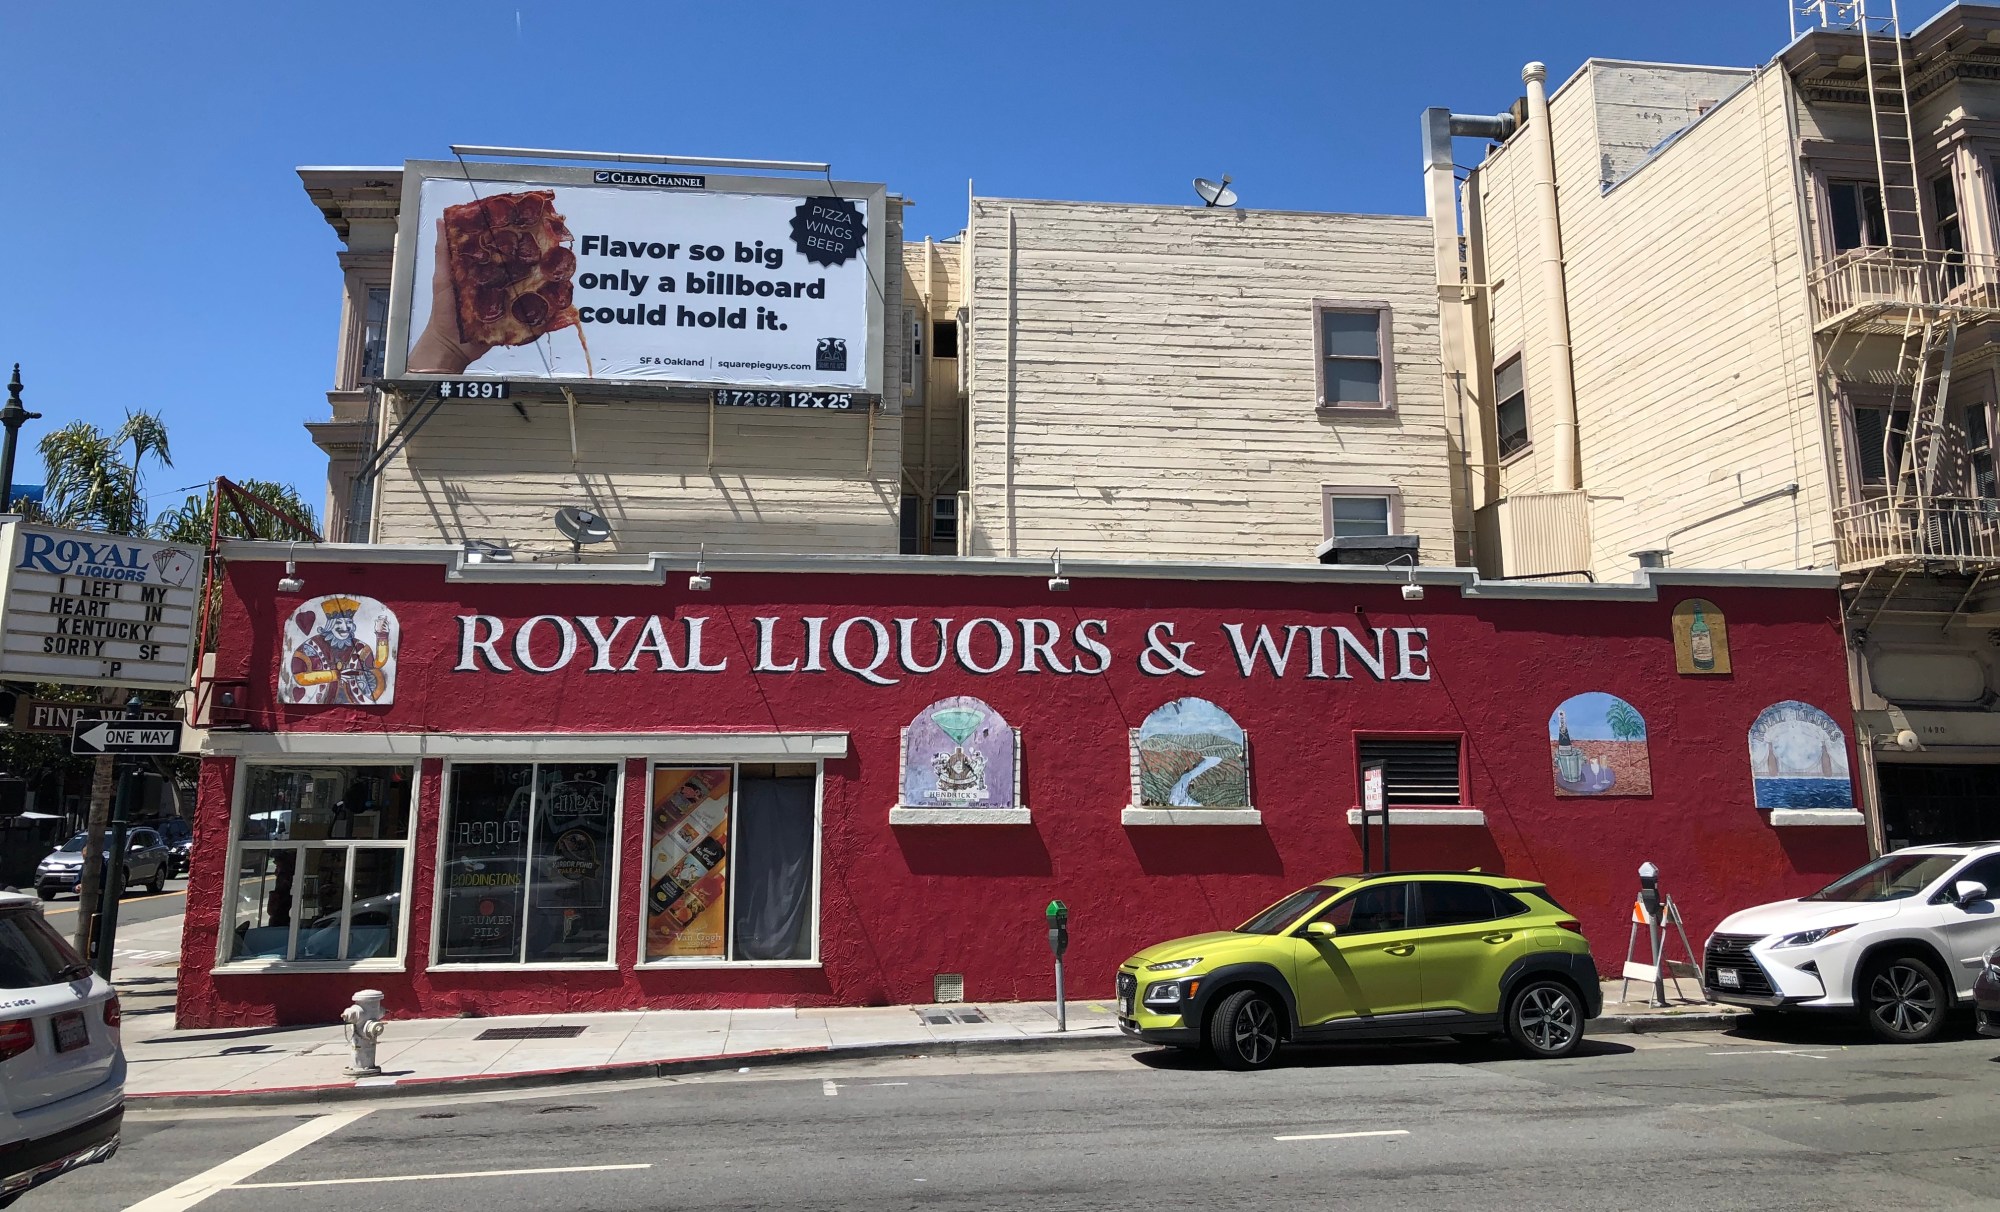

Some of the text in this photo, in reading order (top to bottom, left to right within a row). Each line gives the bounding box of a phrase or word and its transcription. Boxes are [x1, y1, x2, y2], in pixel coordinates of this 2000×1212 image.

[812, 205, 852, 225] PIZZA
[806, 219, 853, 240] WINGS
[581, 235, 783, 269] Flavor so big
[807, 235, 844, 254] BEER
[579, 269, 825, 299] only a billboard
[579, 303, 788, 331] could hold it.
[639, 357, 652, 365] SF
[654, 357, 661, 365] &
[663, 357, 705, 367] Oakland
[717, 359, 811, 371] squarepieguys.com
[16, 532, 150, 575] ROYAL
[75, 564, 147, 583] LIQUORS
[59, 578, 168, 604] I LEFT MY
[49, 597, 162, 622] HEART IN
[57, 618, 153, 640] KENTUCKY
[44, 637, 160, 660] SORRY SF
[454, 614, 1431, 687] ROYAL LIQUORS & WINE
[33, 706, 85, 727] FINE
[1752, 709, 1842, 743] ROYAL LIQUORS
[105, 731, 170, 744] ONE WAY
[559, 794, 599, 812] IPA
[929, 791, 977, 799] HENDRICK'S
[458, 820, 521, 845] ROGUE
[452, 873, 522, 887] BODDINGTONS
[460, 916, 514, 925] TRUMER
[473, 928, 500, 937] PILS
[675, 932, 722, 944] Van Gogh
